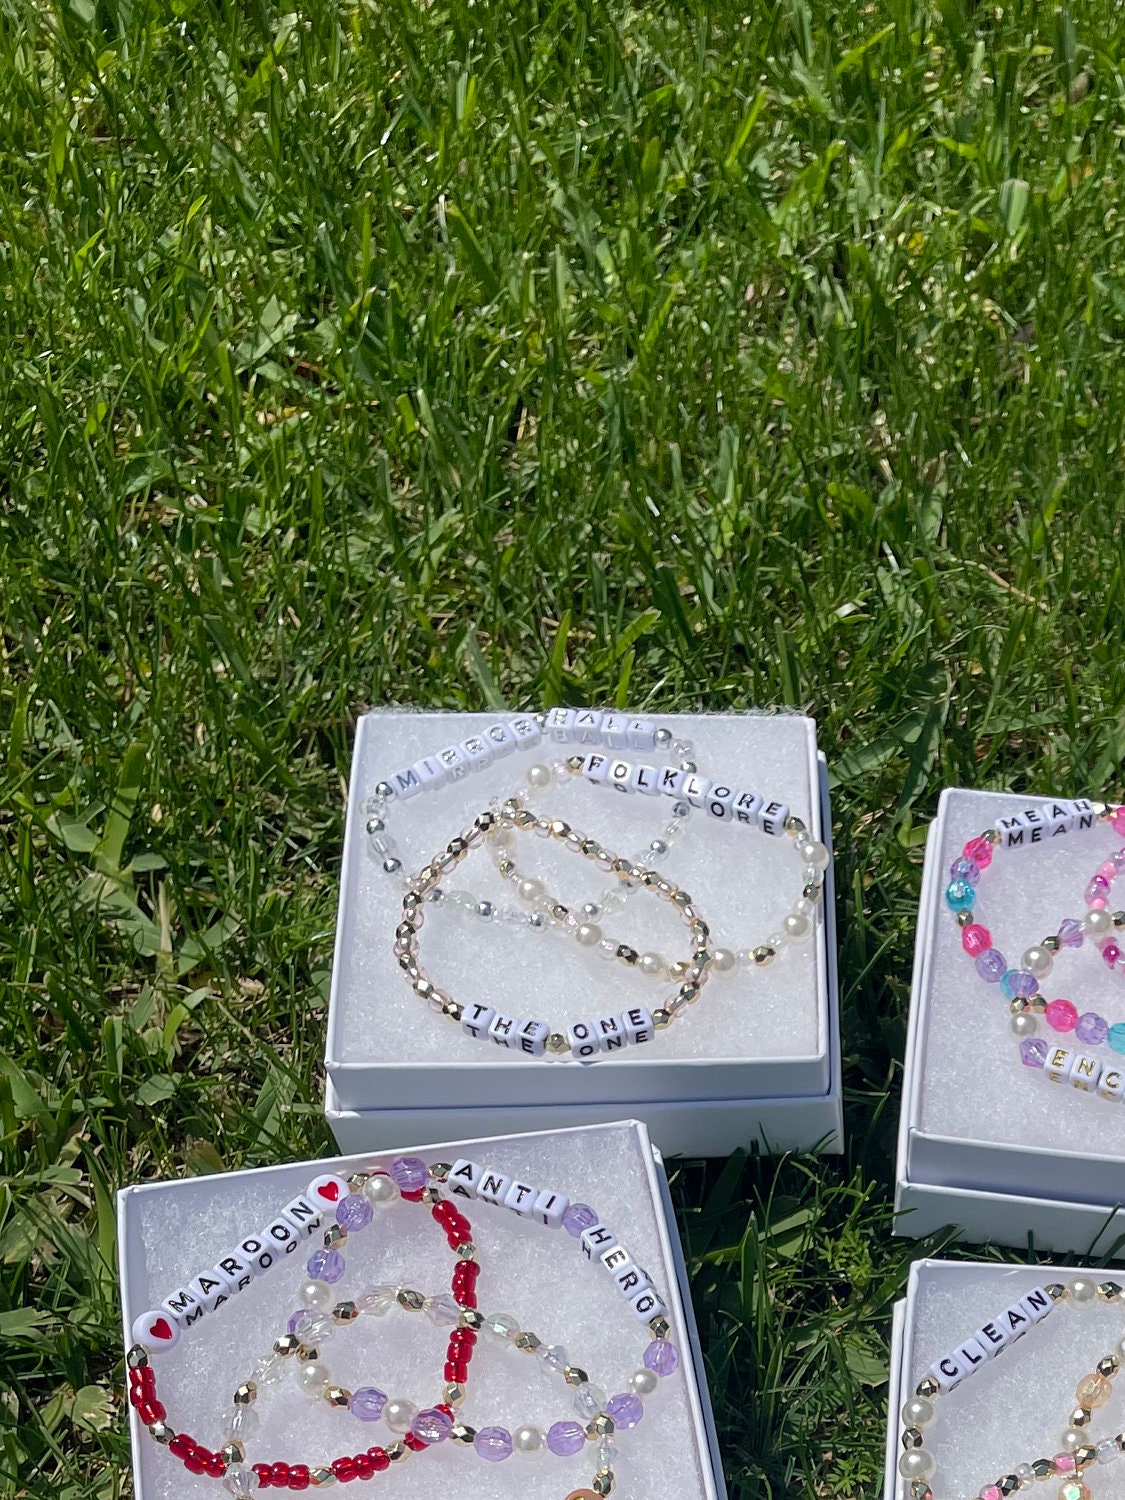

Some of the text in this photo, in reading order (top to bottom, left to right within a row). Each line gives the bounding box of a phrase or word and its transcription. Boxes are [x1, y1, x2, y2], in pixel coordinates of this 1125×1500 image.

[552, 706, 655, 750] BALL
[586, 753, 790, 836] FOLKLORE
[1000, 800, 1094, 847] MEAN
[470, 1003, 651, 1058] THE ONE
[166, 1201, 320, 1318] MAROON
[454, 1163, 659, 1316] ANTI HERO
[938, 1289, 1050, 1378] CLEAN
